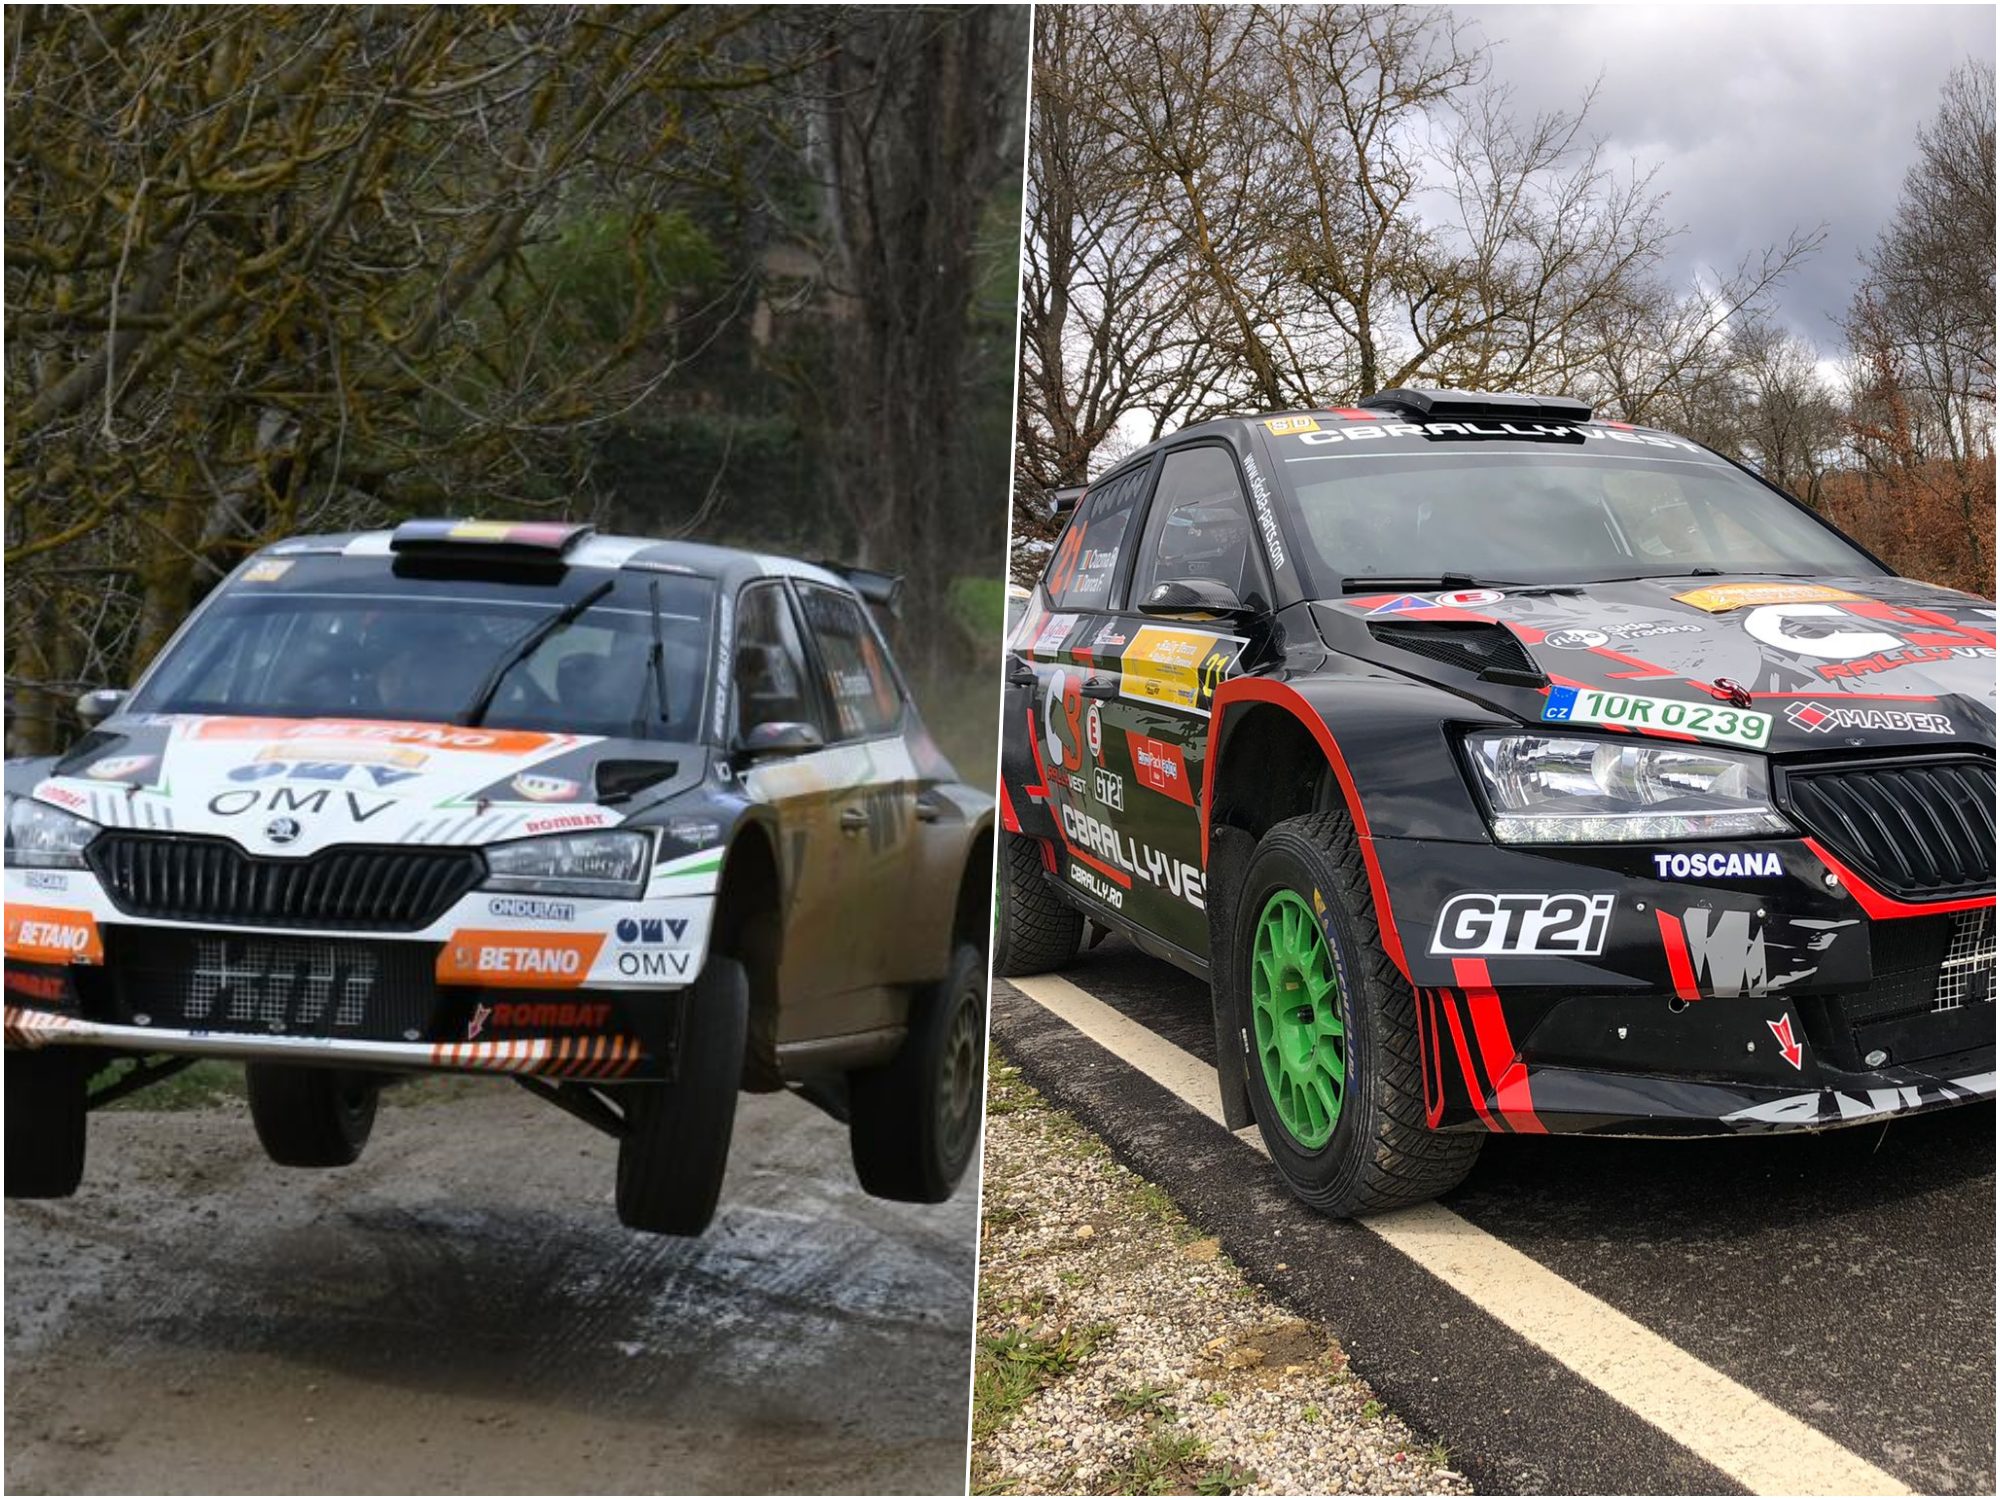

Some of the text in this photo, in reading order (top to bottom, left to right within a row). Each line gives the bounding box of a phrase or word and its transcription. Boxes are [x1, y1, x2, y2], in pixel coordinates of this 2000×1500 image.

[1299, 421, 1699, 454] CBRALLYVEST
[1243, 452, 1285, 571] www.skoda-parts.com
[1049, 519, 1088, 595] 21
[1600, 622, 1655, 634] Side
[1611, 623, 1704, 640] Trading
[1546, 707, 1567, 719] CZ
[1587, 692, 1766, 740] 10R 0239
[1834, 708, 1956, 735] MABER
[1094, 767, 1124, 811] GT2i
[208, 788, 399, 823] OMV
[525, 814, 606, 832] ROMBAT
[1654, 853, 1783, 878] TOSCANA
[1070, 863, 1123, 909] CBRALLY.RO
[488, 899, 575, 921] ONDULATI
[1435, 894, 1612, 954] GT2i
[18, 920, 89, 953] BETANO
[477, 946, 581, 974] BETANO
[618, 951, 690, 975] OMV
[492, 1003, 612, 1027] ROMBAT
